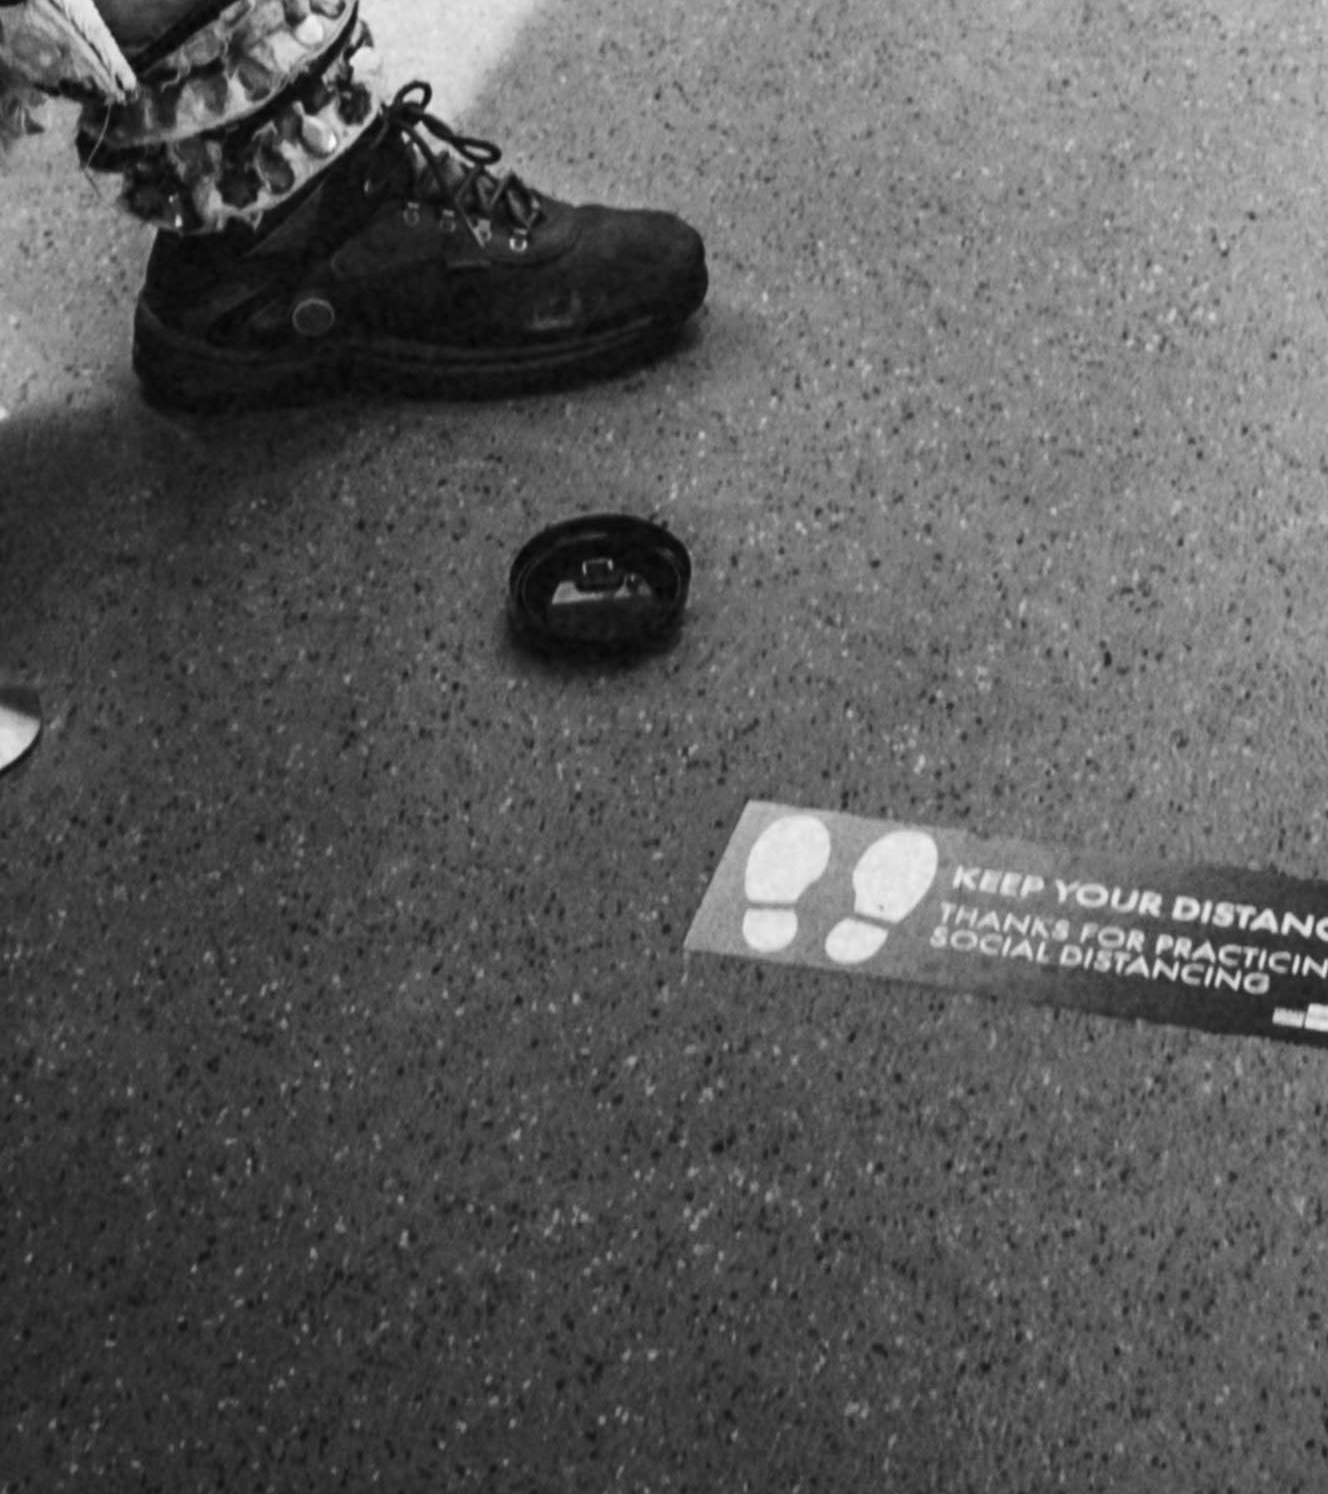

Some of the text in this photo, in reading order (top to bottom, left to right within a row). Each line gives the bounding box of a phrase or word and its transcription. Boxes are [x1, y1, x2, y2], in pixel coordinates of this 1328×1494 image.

[952, 865, 1045, 899] KEEP
[1055, 878, 1163, 918] YOUR
[940, 901, 1071, 943] THANKS
[1080, 922, 1146, 953] FOR
[929, 925, 1272, 996] SOCIAL DISTANCING
